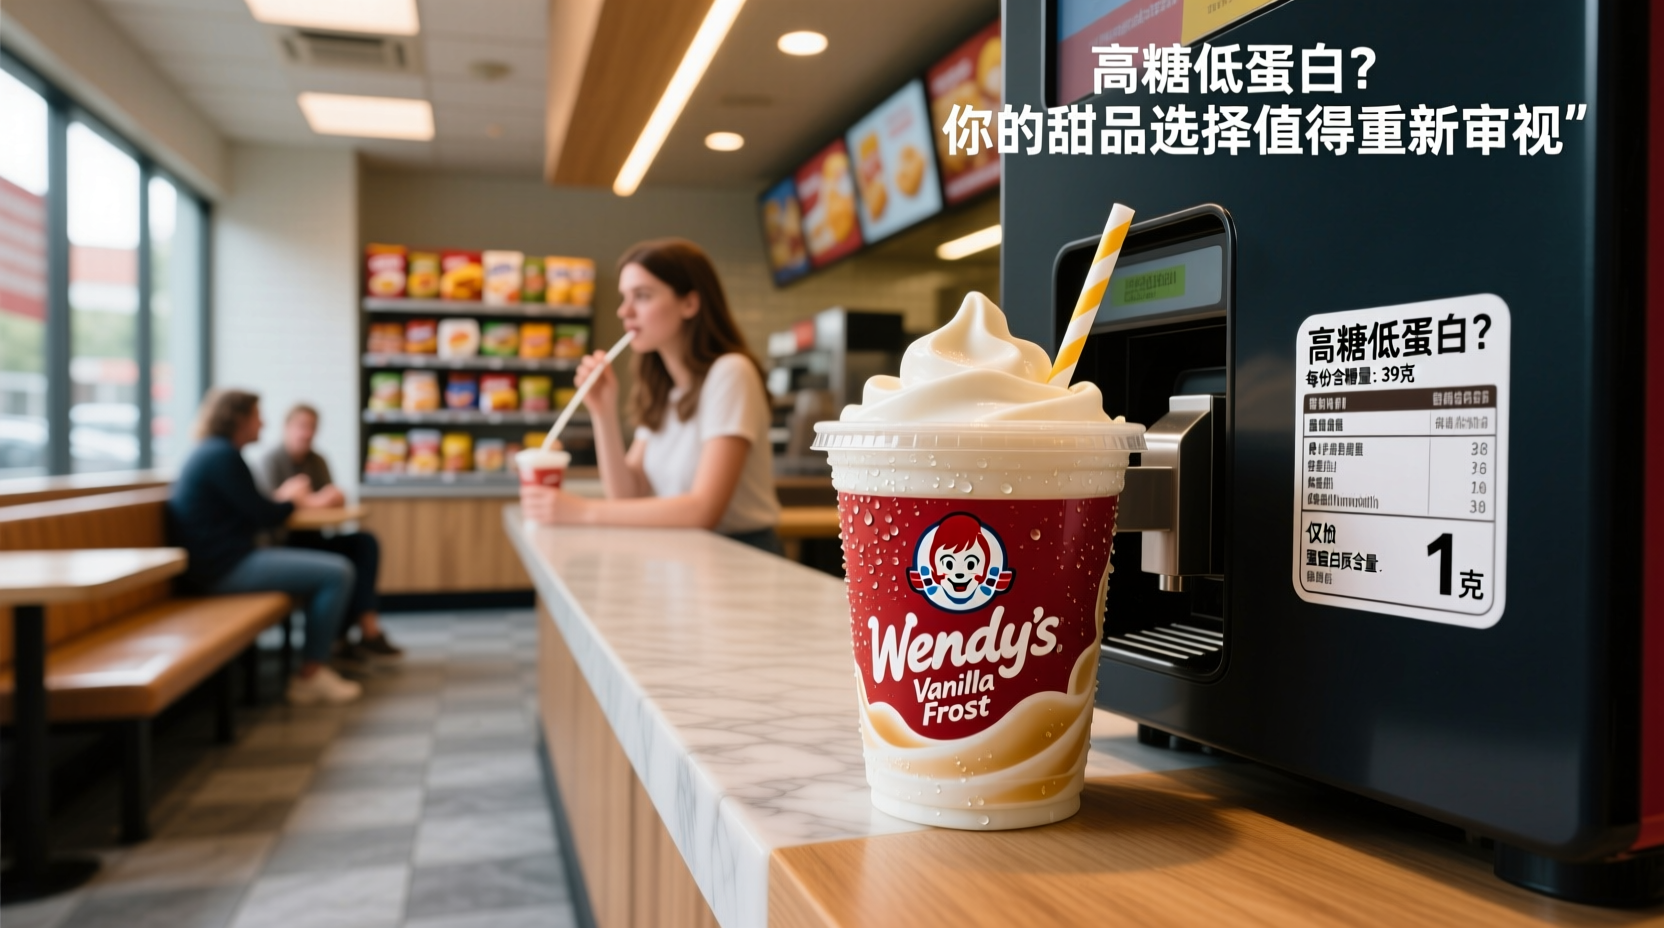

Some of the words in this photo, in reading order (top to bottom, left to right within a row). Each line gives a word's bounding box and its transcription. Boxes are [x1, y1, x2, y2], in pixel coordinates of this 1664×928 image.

[1381, 363, 1415, 384] 39克
[868, 605, 1060, 684] Wendy's
[913, 669, 995, 703] Vanilla
[922, 695, 991, 727] Frost
